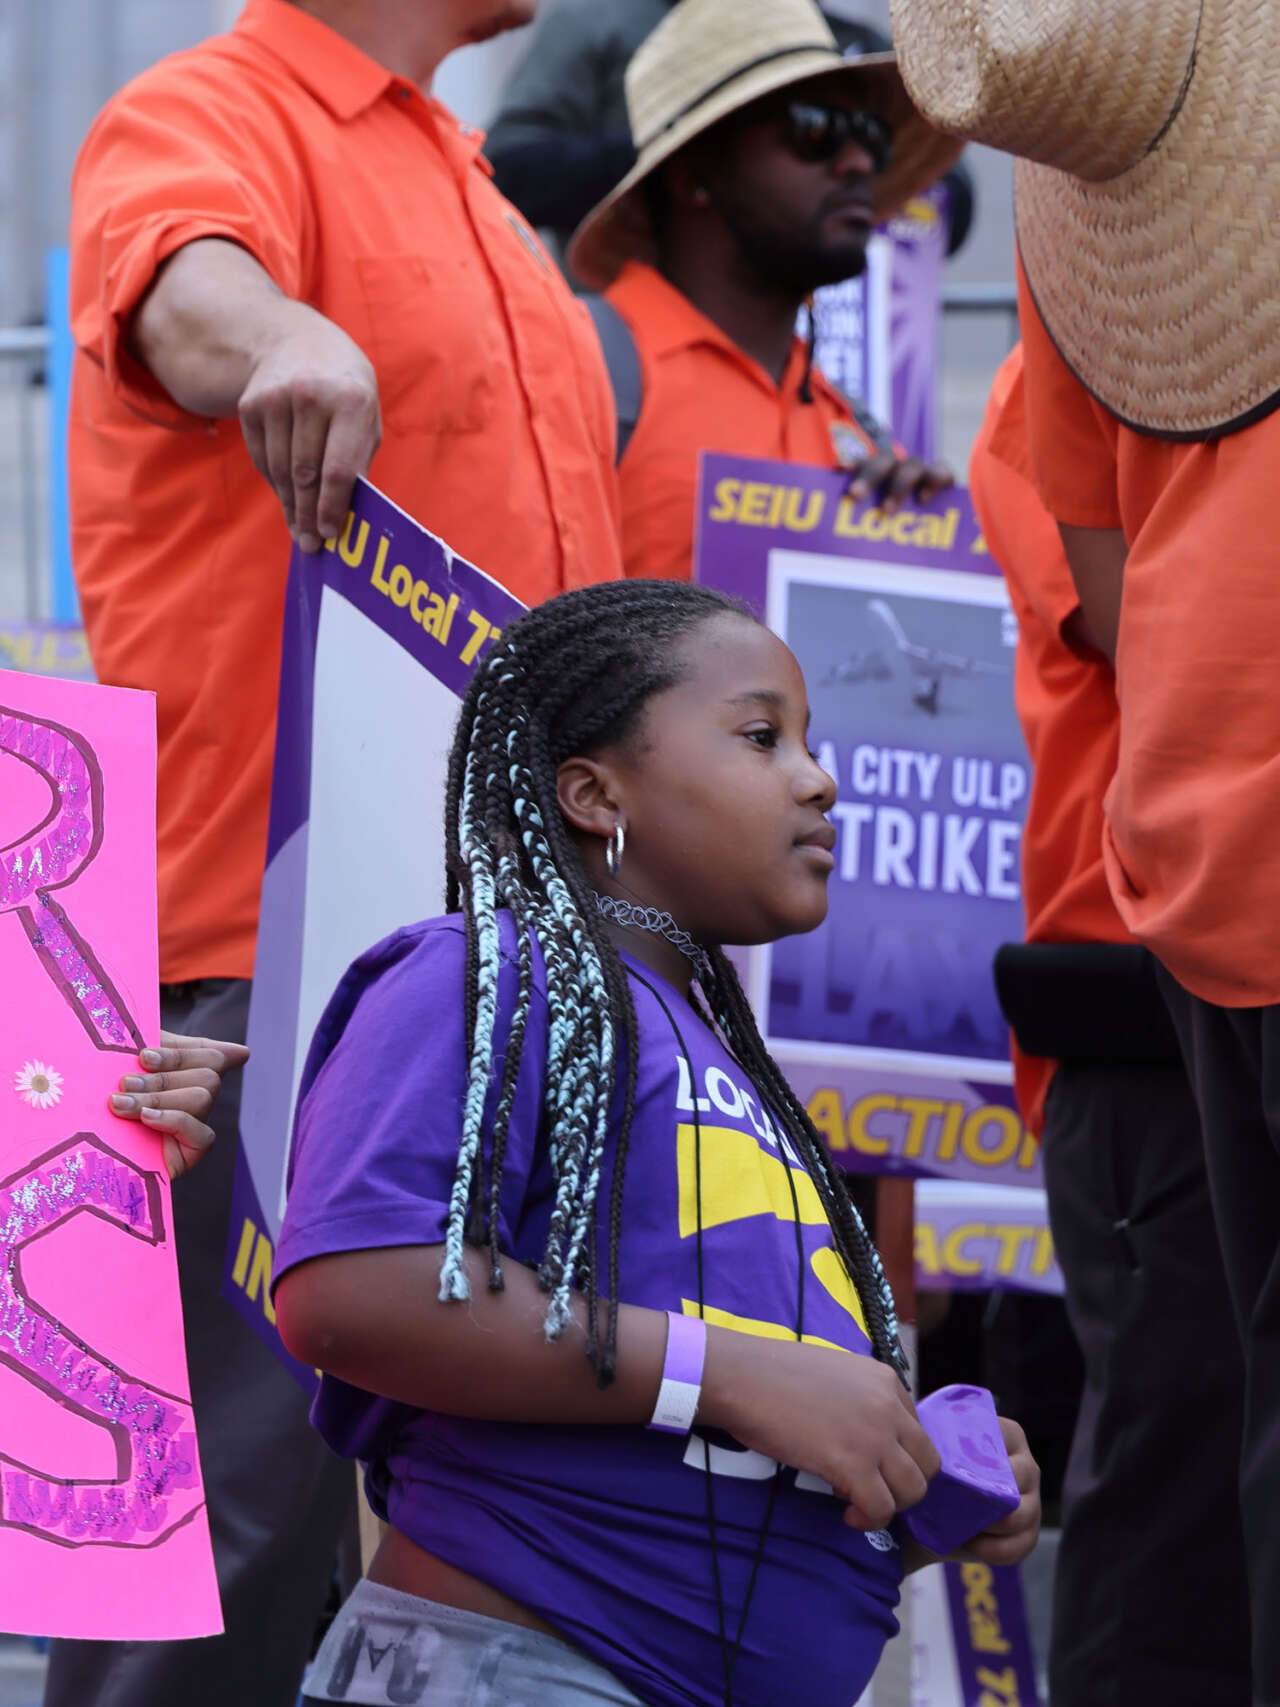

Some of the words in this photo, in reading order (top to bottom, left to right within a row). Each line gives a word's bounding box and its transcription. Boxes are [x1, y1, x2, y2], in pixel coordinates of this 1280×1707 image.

[709, 478, 824, 533] SEIU
[833, 494, 960, 551] Local
[370, 535, 460, 647] Local
[851, 743, 941, 802] CITY
[951, 756, 1026, 812] ULP
[824, 800, 1021, 901] TRIKE
[962, 1562, 1011, 1654] ocal
